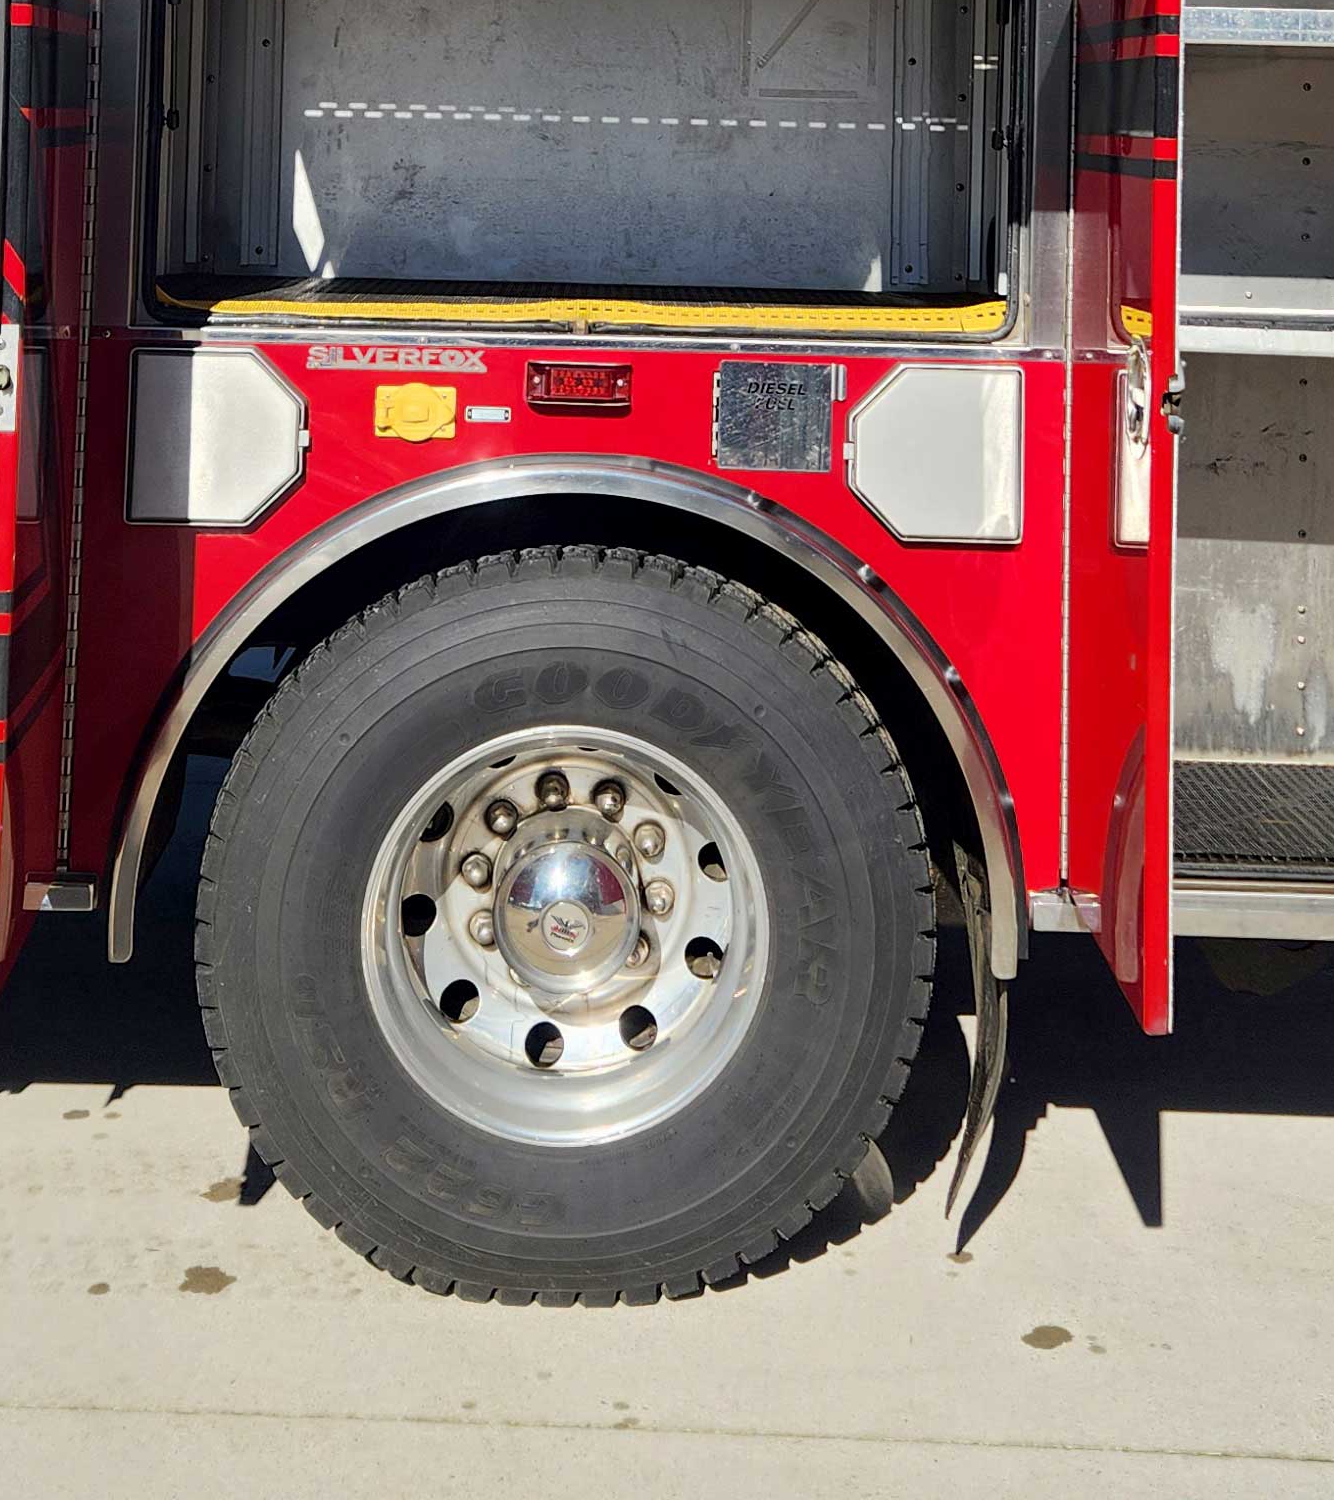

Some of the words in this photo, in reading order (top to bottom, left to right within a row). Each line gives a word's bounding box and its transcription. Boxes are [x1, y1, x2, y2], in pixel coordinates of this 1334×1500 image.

[306, 346, 488, 372] SILVERFOX
[747, 381, 806, 396] DIESEL
[754, 396, 796, 411] FUEL
[475, 662, 833, 1006] GOODYEAR
